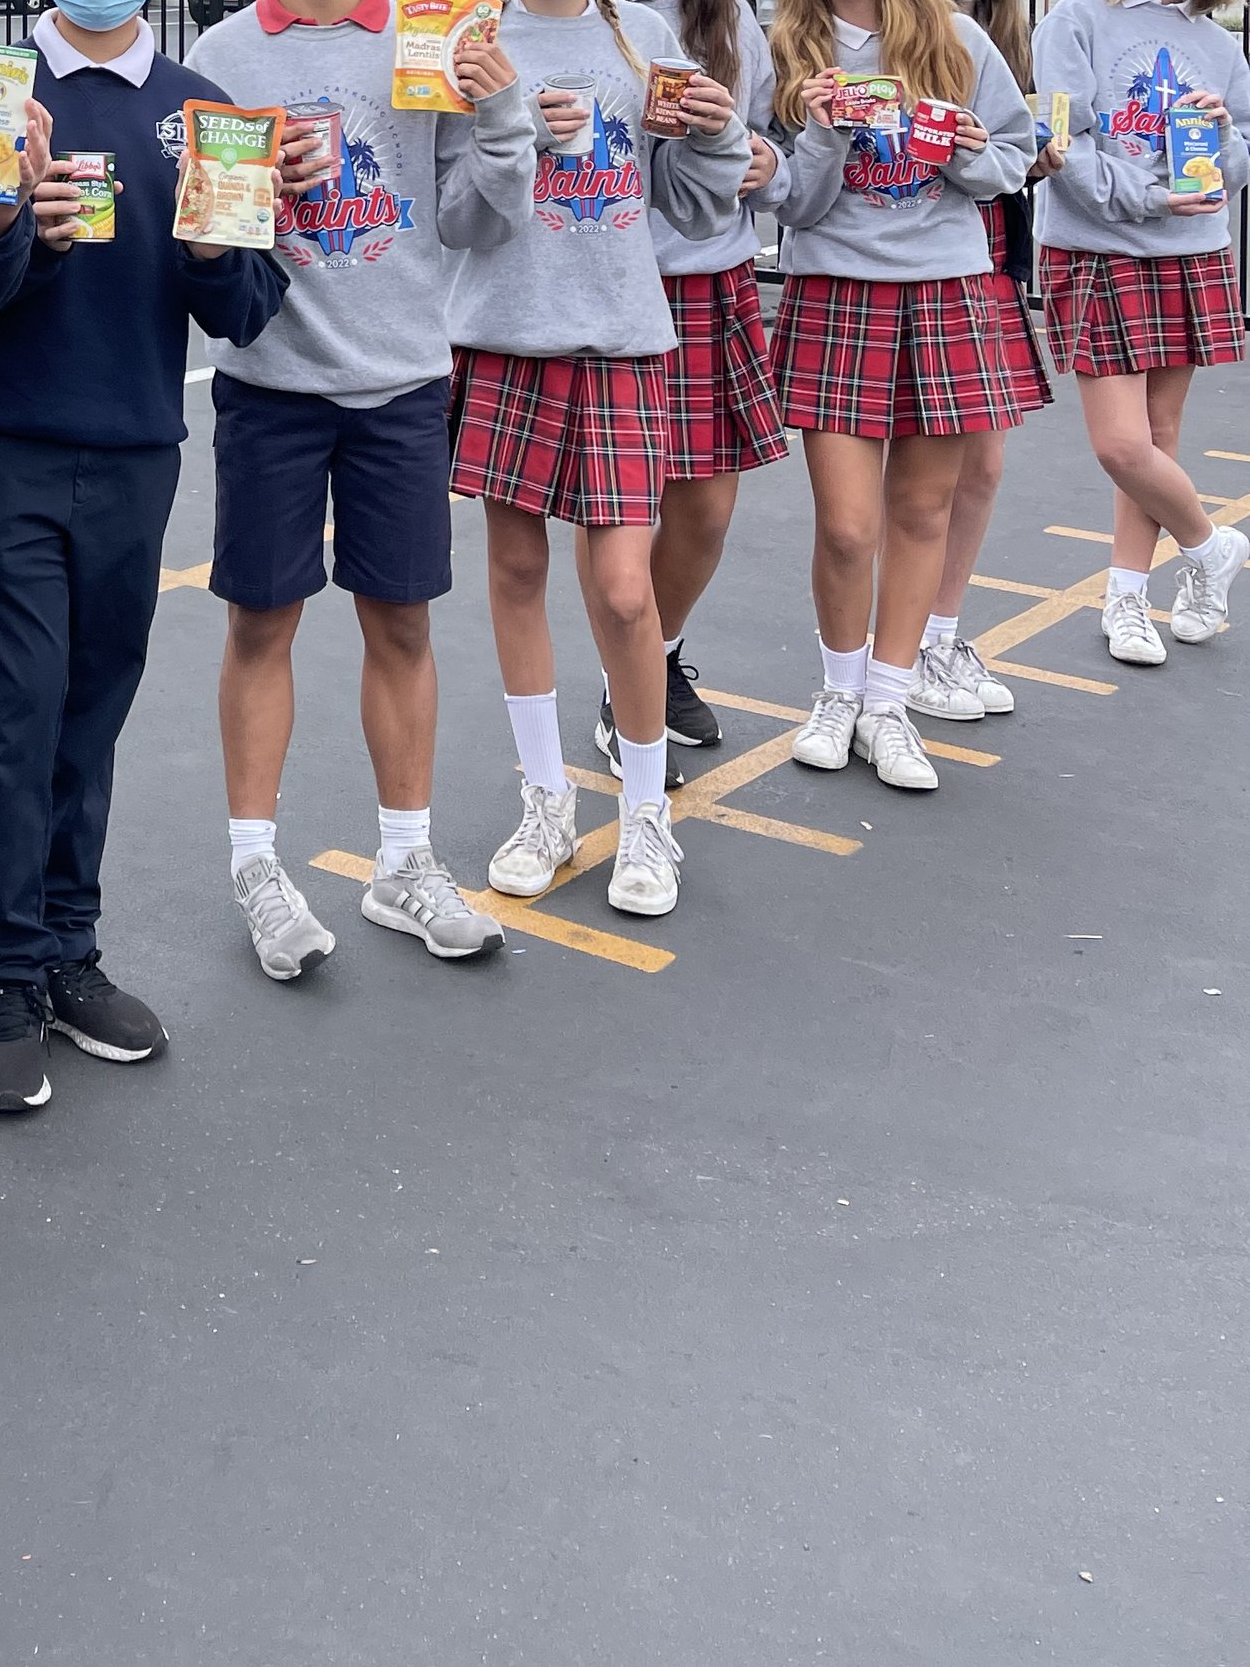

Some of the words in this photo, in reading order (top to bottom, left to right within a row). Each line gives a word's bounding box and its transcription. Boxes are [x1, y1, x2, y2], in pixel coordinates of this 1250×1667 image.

[406, 3, 429, 15] TASTY
[430, 1, 449, 12] BITE
[406, 41, 441, 52] Madras
[408, 49, 440, 59] Lentils
[869, 83, 896, 97] play
[657, 100, 681, 110] WHITE
[655, 107, 679, 117] KIDNE
[199, 115, 254, 132] SEEDS
[255, 121, 271, 134] of
[656, 115, 678, 124] BEANS
[1175, 115, 1215, 129] Annies
[199, 131, 267, 149] CHANGE
[912, 129, 952, 147] MILK
[534, 156, 644, 203] Saints
[91, 187, 112, 198] Corn
[274, 185, 401, 235] Saints
[897, 201, 916, 209] 2022
[578, 225, 599, 234] 2022
[326, 259, 350, 269] 2022
